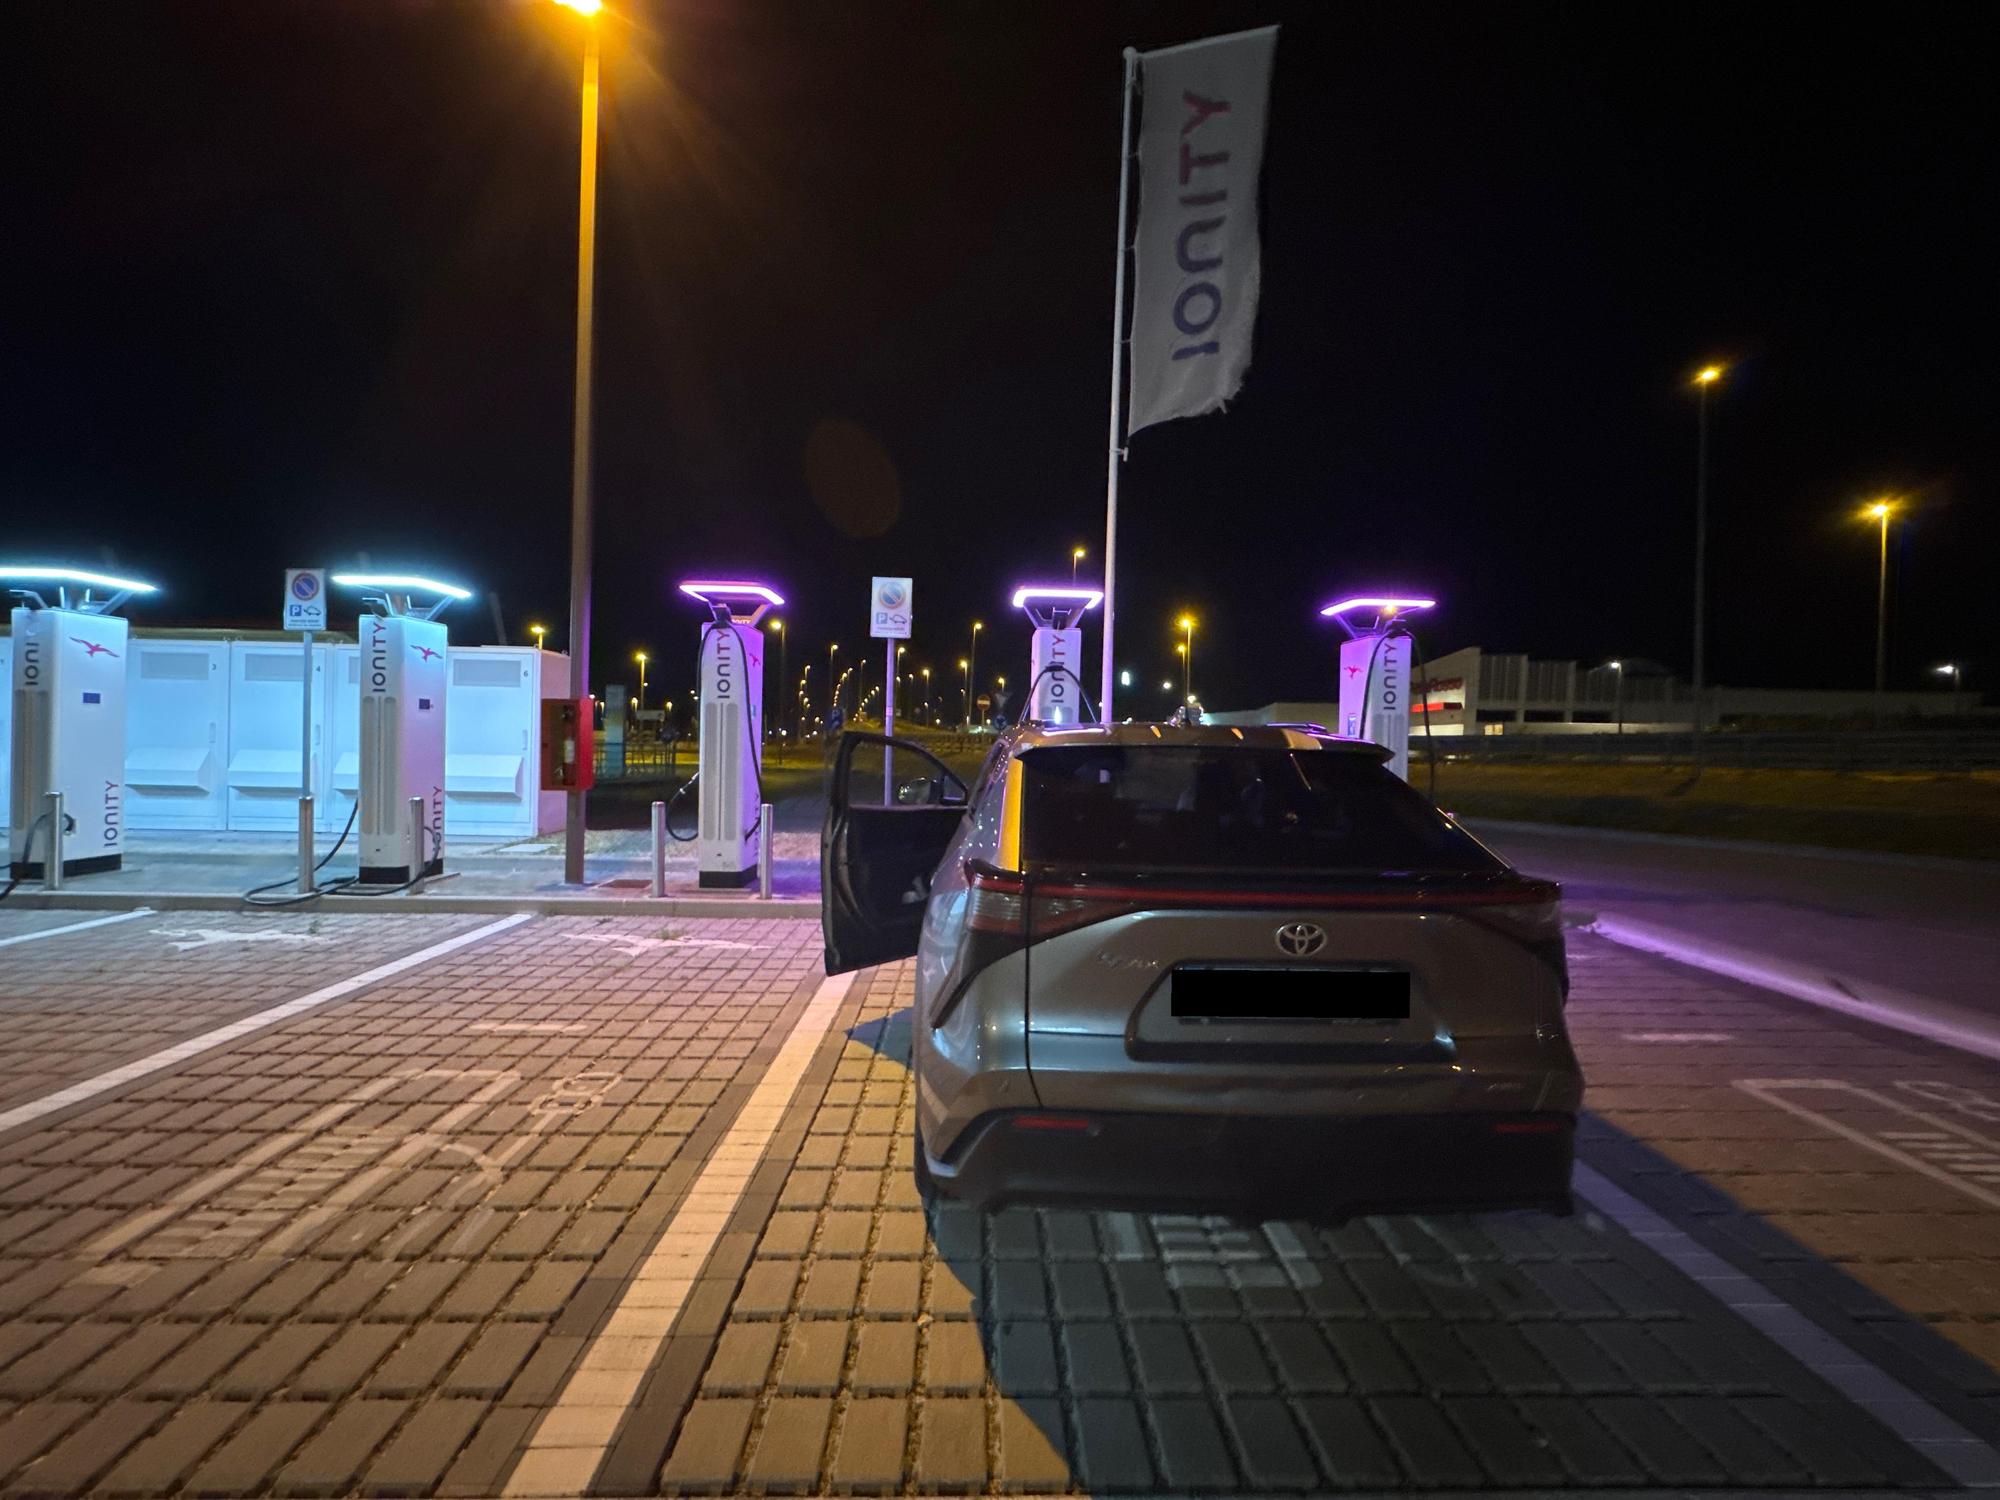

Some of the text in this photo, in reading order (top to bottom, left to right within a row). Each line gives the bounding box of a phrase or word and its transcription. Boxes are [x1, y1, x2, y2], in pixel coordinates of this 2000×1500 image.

[1172, 89, 1231, 361] IONITY
[25, 629, 39, 685] IONI
[372, 622, 386, 692] IONITY
[717, 628, 731, 699] IONITY
[1383, 643, 1397, 710] IONITY
[104, 780, 119, 847] IONITY
